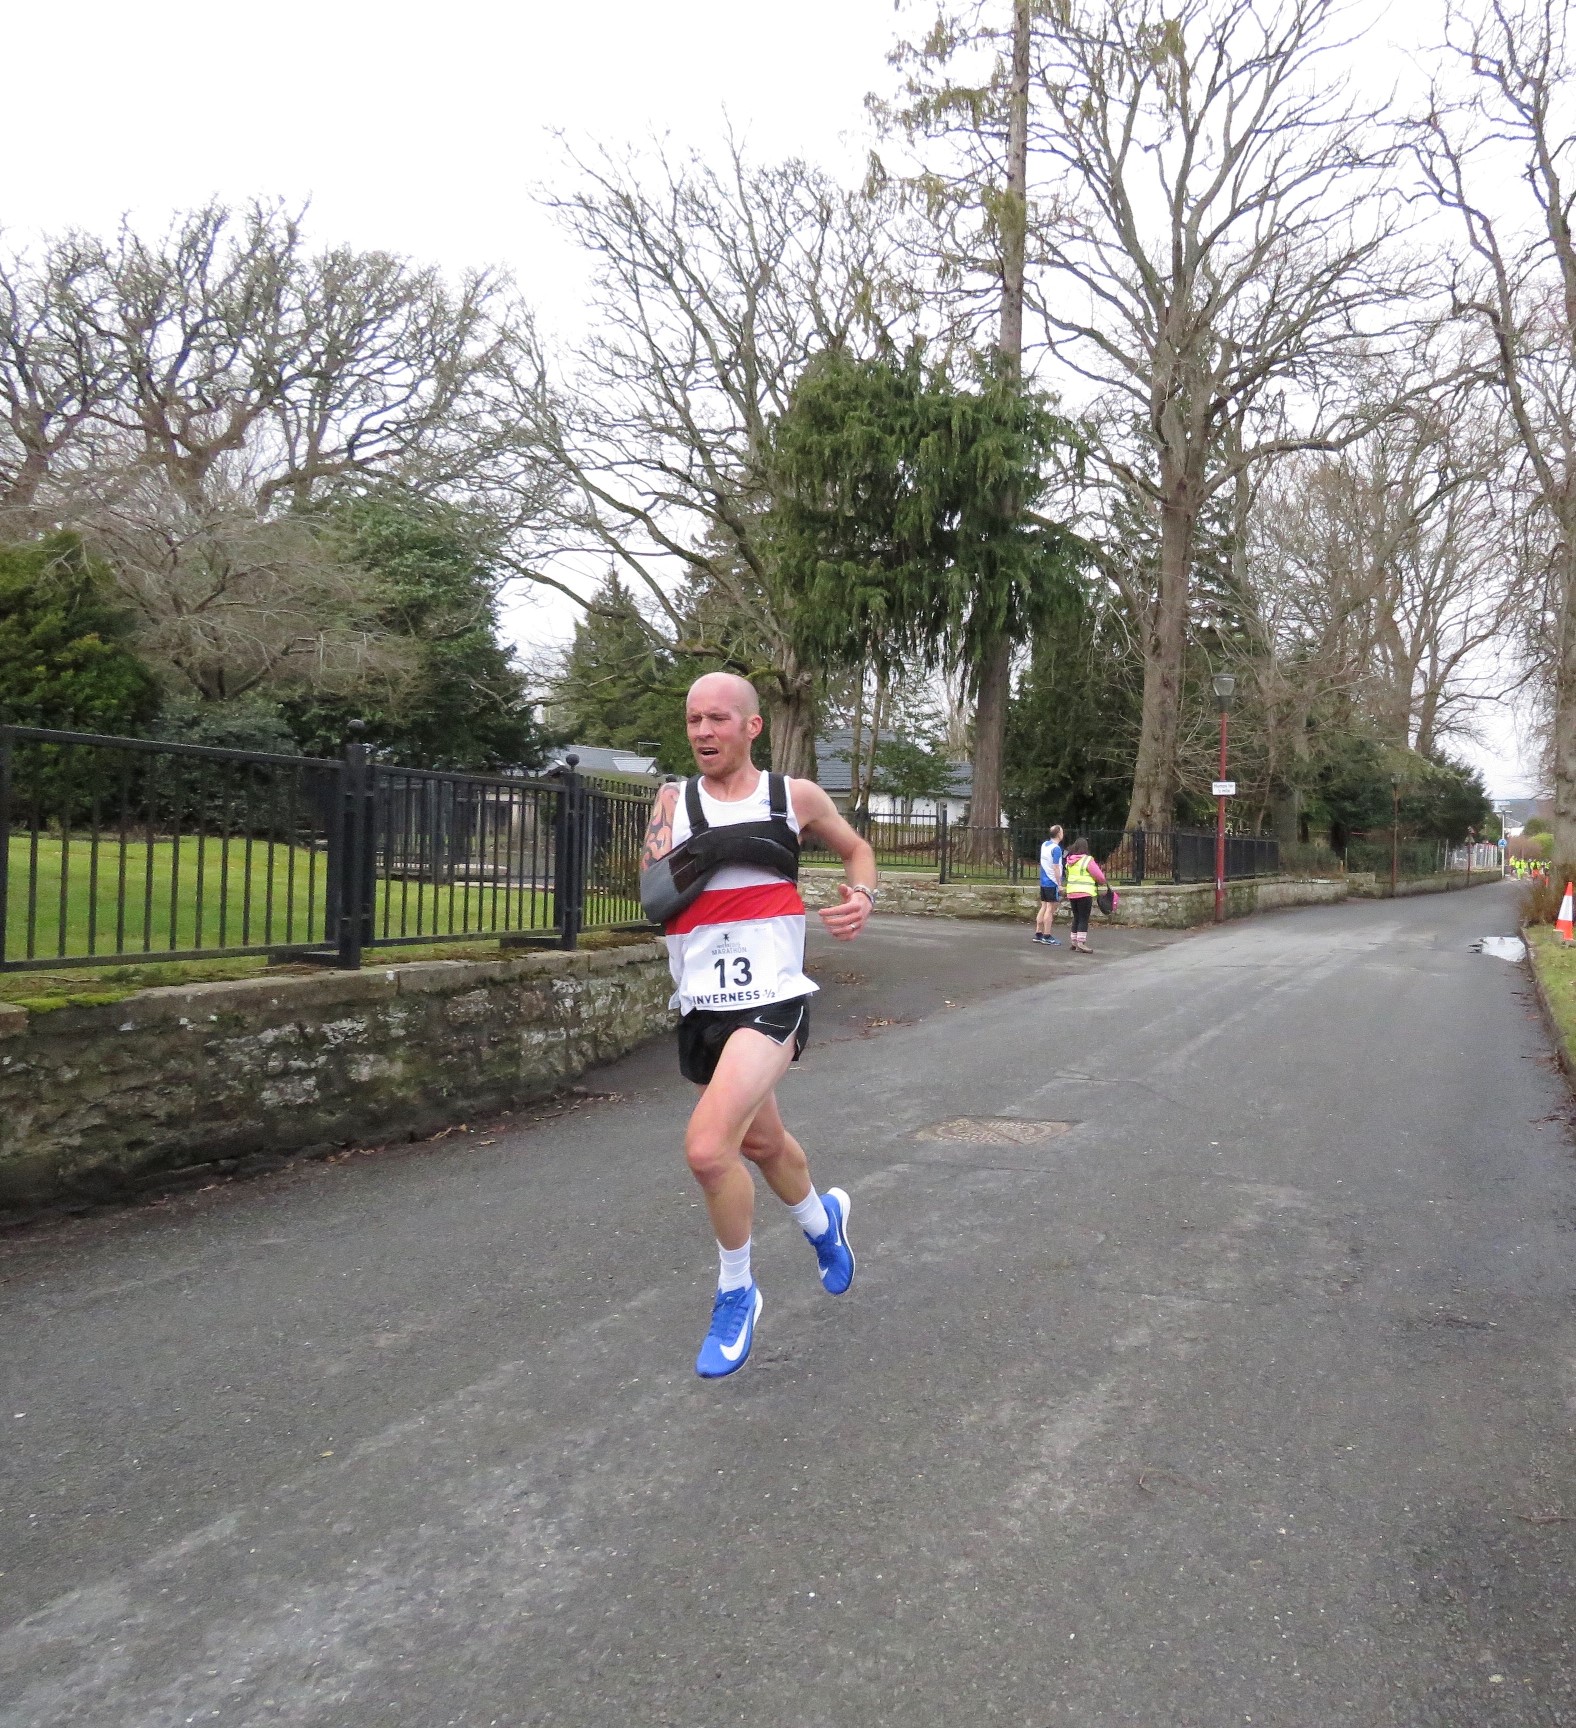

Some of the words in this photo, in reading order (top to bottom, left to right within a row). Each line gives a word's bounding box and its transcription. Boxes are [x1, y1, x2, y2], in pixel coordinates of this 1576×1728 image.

[711, 947, 747, 955] MARATHON
[714, 957, 753, 988] 13
[692, 990, 760, 1004] INVERNESS
